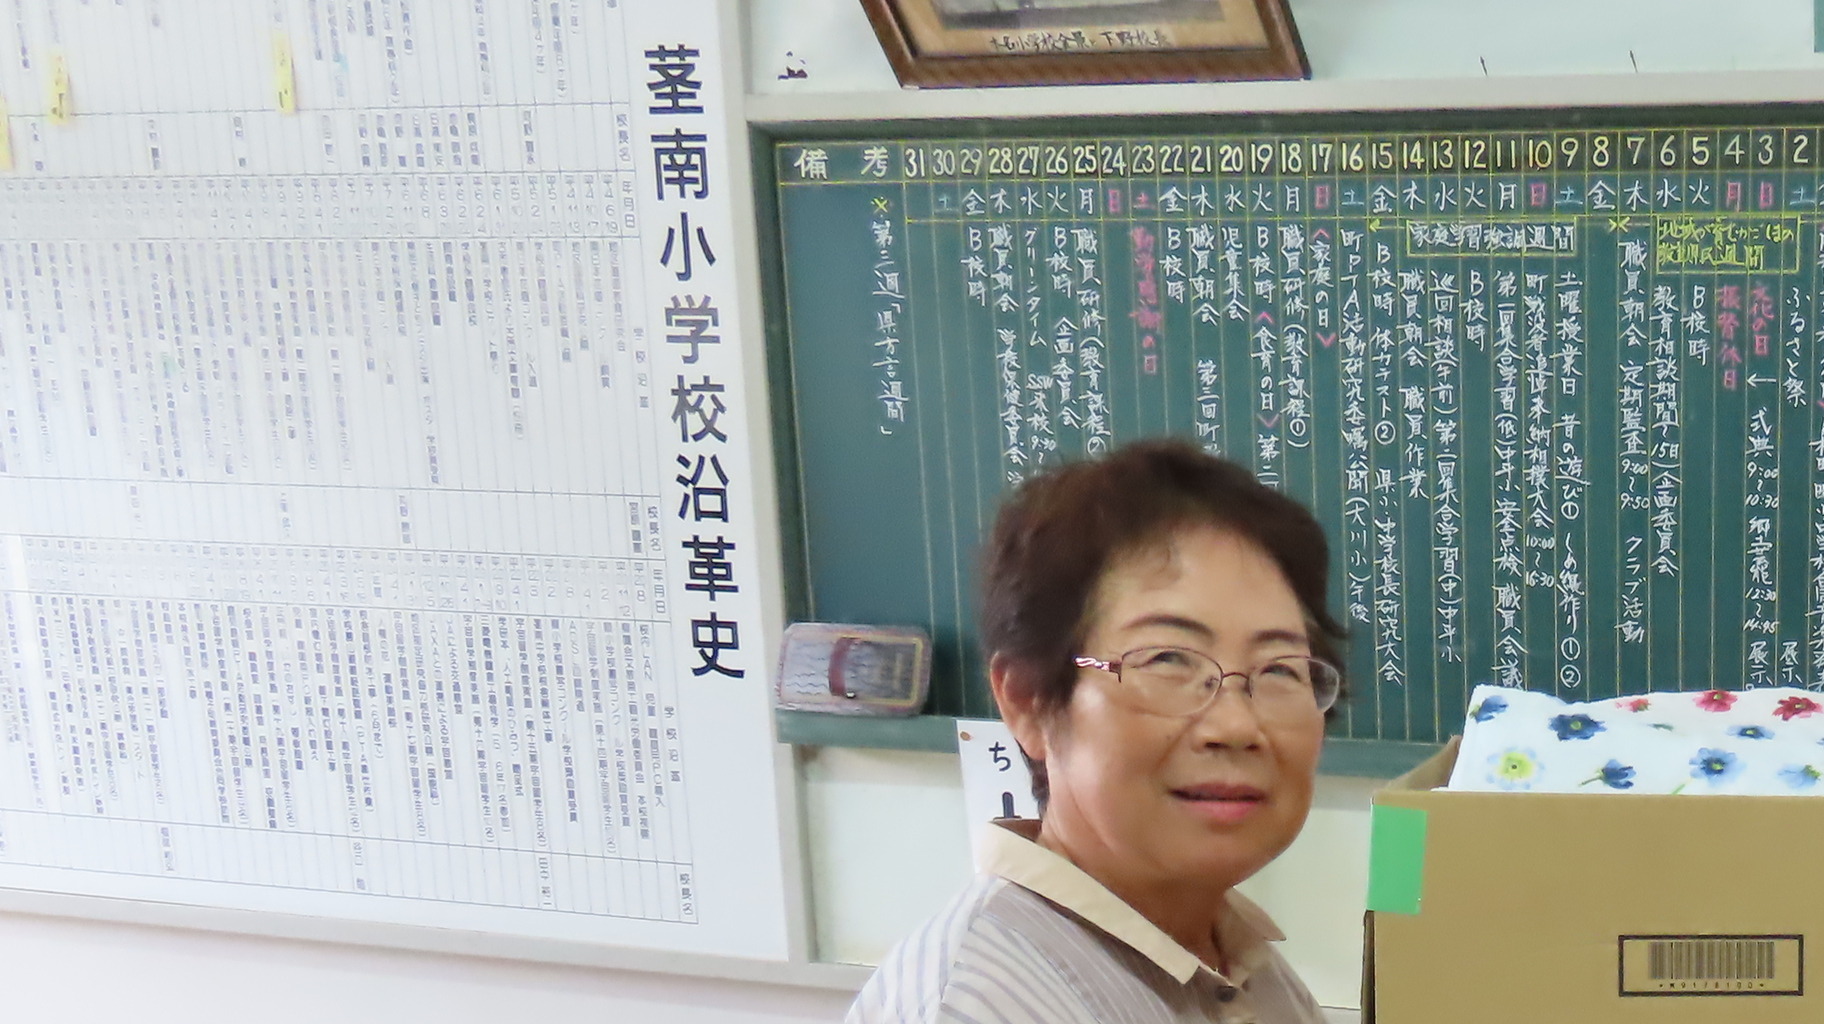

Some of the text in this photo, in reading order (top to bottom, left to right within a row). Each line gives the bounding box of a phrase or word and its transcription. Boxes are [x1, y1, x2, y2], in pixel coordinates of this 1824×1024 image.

[794, 147, 890, 178] 備考
[904, 148, 926, 178] 31
[932, 147, 956, 176] 30
[960, 147, 983, 175] 29
[988, 145, 1014, 174] 28
[1016, 146, 1040, 176] 27
[1045, 145, 1069, 175] 26
[1073, 144, 1097, 175] 25
[1102, 145, 1128, 176] 24
[1131, 144, 1155, 174] 23
[1159, 144, 1185, 174] 22
[1190, 145, 1212, 173] 21
[1219, 144, 1245, 172] 20
[1250, 143, 1274, 173] 19
[1280, 143, 1303, 172] 18
[1311, 144, 1332, 173] 17
[1341, 143, 1364, 171] 16
[1371, 142, 1393, 171] 15
[1402, 140, 1426, 171] 14
[1432, 139, 1454, 170] 13
[1463, 139, 1487, 170] 12
[1496, 139, 1516, 170] 11
[1529, 139, 1553, 171] 10
[1560, 136, 1579, 168] 9
[1592, 135, 1611, 168] 8
[1626, 136, 1646, 165] 7
[1659, 134, 1676, 167] 6
[1691, 136, 1710, 166] 5
[1724, 134, 1745, 165] 4
[1757, 134, 1774, 165] 3
[1793, 134, 1811, 164] 2
[962, 188, 986, 216] 金
[989, 187, 1013, 215] 木
[1019, 187, 1044, 216] 水
[1047, 186, 1070, 213] 火
[1078, 187, 1096, 216] 月
[1107, 189, 1121, 213] 日
[1160, 185, 1187, 213] 金
[1191, 184, 1215, 216] 木
[1224, 184, 1246, 213] 水
[1252, 183, 1274, 213] 火
[1285, 184, 1300, 213] 月
[1314, 185, 1330, 209] 日
[1342, 187, 1364, 206] 土
[1370, 184, 1397, 213] 金
[1403, 182, 1426, 211] 木
[1434, 181, 1458, 211] 水
[1464, 182, 1486, 209] 火
[1498, 182, 1517, 210] 月
[1530, 183, 1547, 207] 日
[1556, 185, 1583, 205] 土
[1588, 179, 1616, 210] 金
[1623, 180, 1649, 212] 木
[1656, 178, 1681, 209] 水
[1688, 180, 1711, 205] 火
[1759, 181, 1774, 210] 日
[1789, 185, 1816, 206] 土
[961, 229, 989, 307] B校時
[988, 224, 1019, 313] 職員朝会
[1046, 228, 1074, 298] B校時
[1159, 227, 1187, 304] B校時
[1186, 223, 1221, 327] 職員朝会
[1219, 227, 1250, 322] 児童集会
[1252, 226, 1276, 304] B校時
[1409, 222, 1576, 254] 家庭学習強調週間
[1025, 227, 1048, 348] グリーンタイム
[1368, 243, 1397, 318] B校時
[1459, 270, 1489, 353] B校時
[643, 43, 746, 680] 茎南小学校沿革史
[1680, 285, 1711, 366] B校時
[1783, 286, 1811, 408] ふるさと祭
[1397, 271, 1430, 500] 職員朝会 職員作業
[1615, 239, 1648, 644] 職員朝会 クラブ活動
[988, 741, 1012, 772] ち
